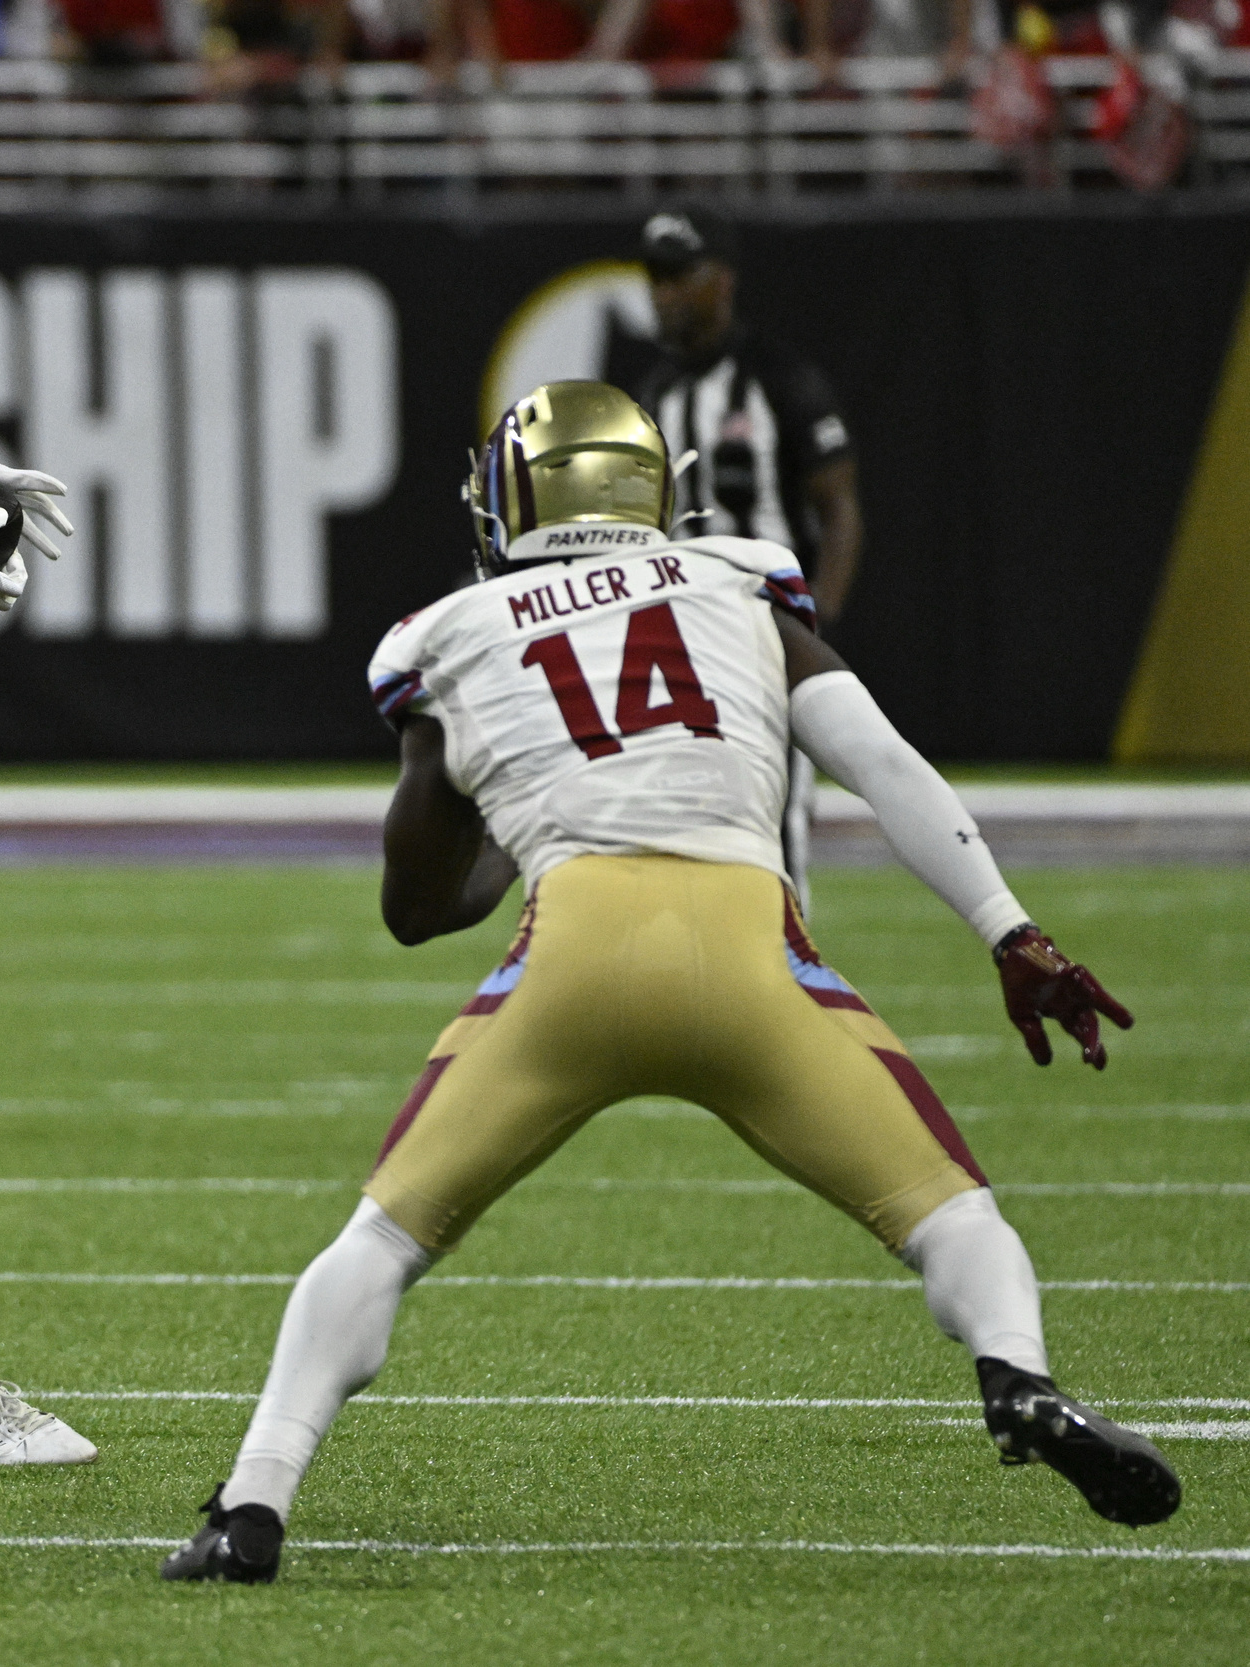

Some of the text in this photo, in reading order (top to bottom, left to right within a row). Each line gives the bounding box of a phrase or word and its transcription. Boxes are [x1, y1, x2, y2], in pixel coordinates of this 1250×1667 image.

[546, 529, 651, 548] PANTHERS
[507, 556, 688, 629] MILLER JR
[520, 601, 726, 761] 14
